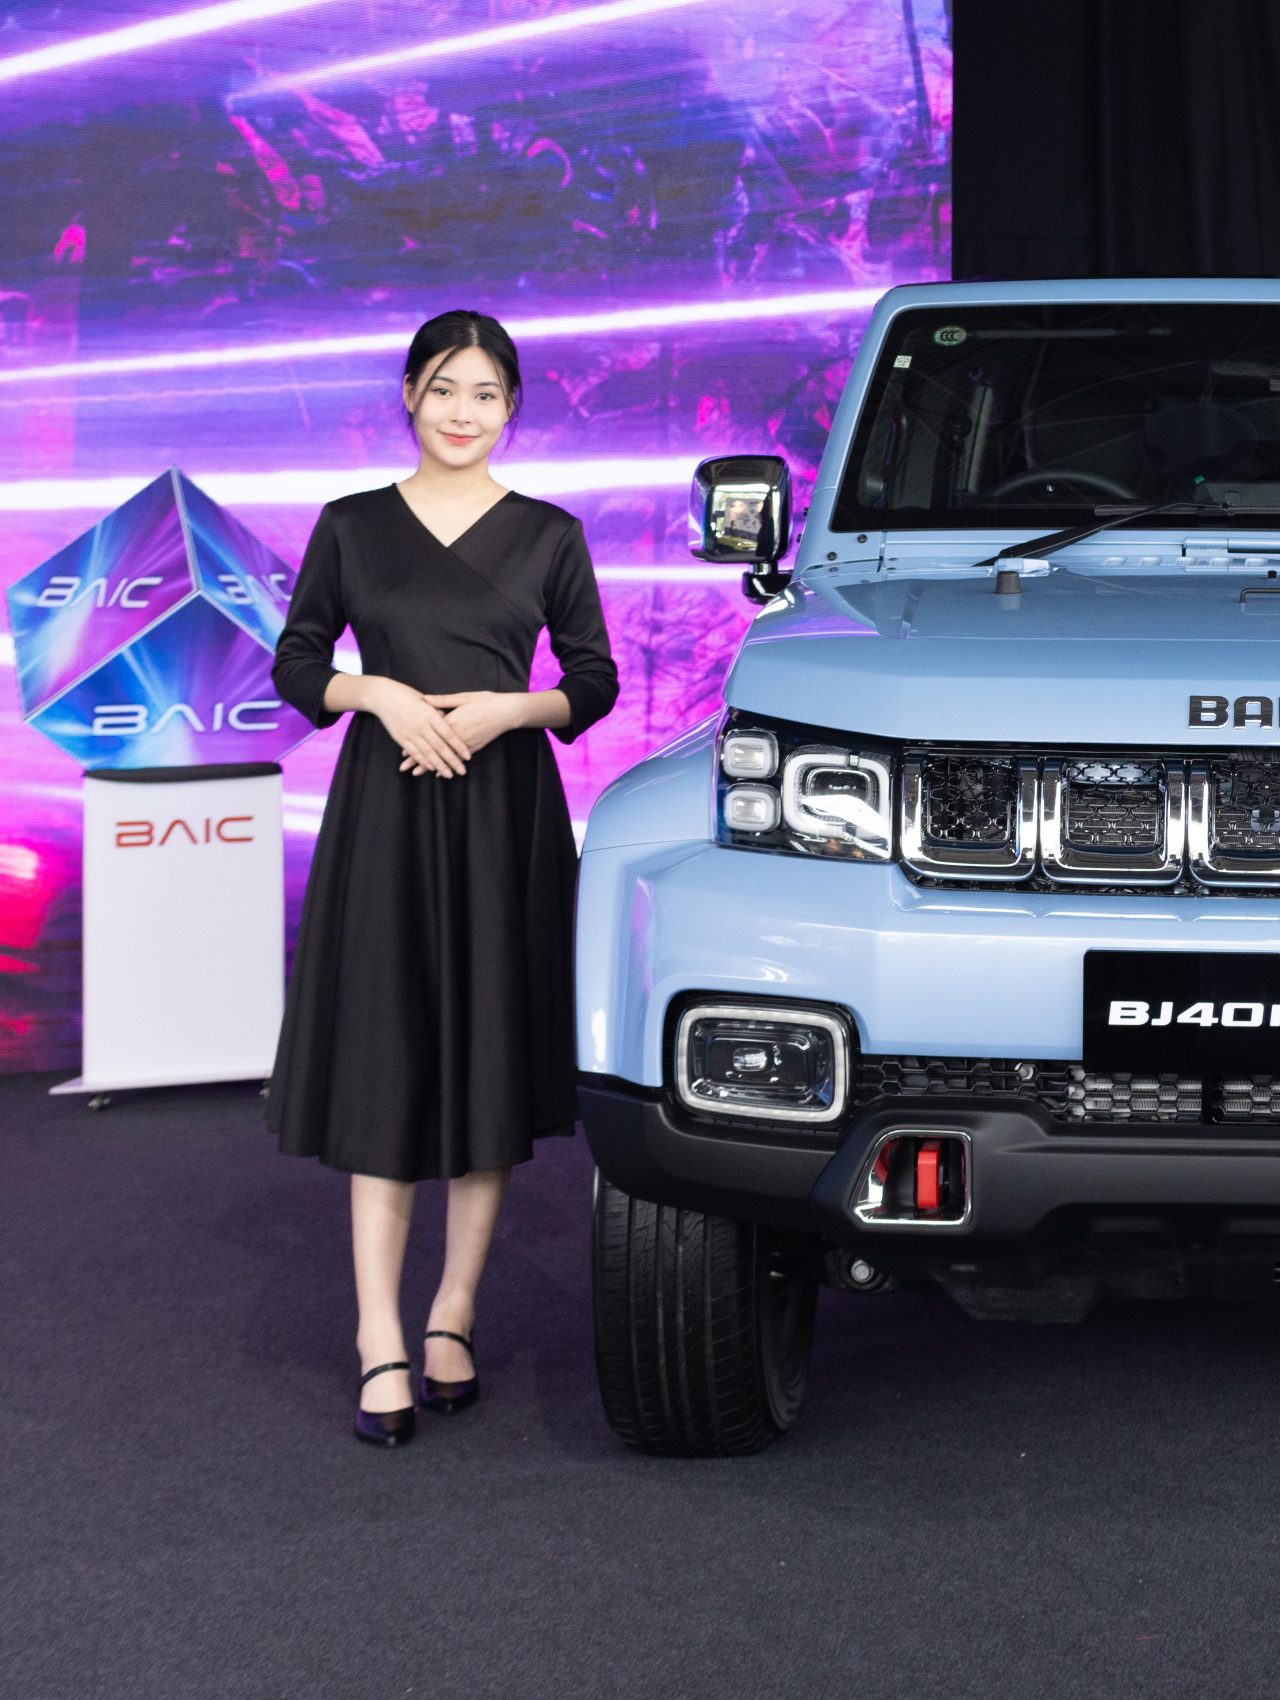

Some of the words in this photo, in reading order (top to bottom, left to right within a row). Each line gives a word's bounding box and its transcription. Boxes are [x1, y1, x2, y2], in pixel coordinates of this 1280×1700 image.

[37, 576, 163, 609] BAIC
[93, 701, 282, 735] BAIC
[115, 816, 254, 848] BAIC
